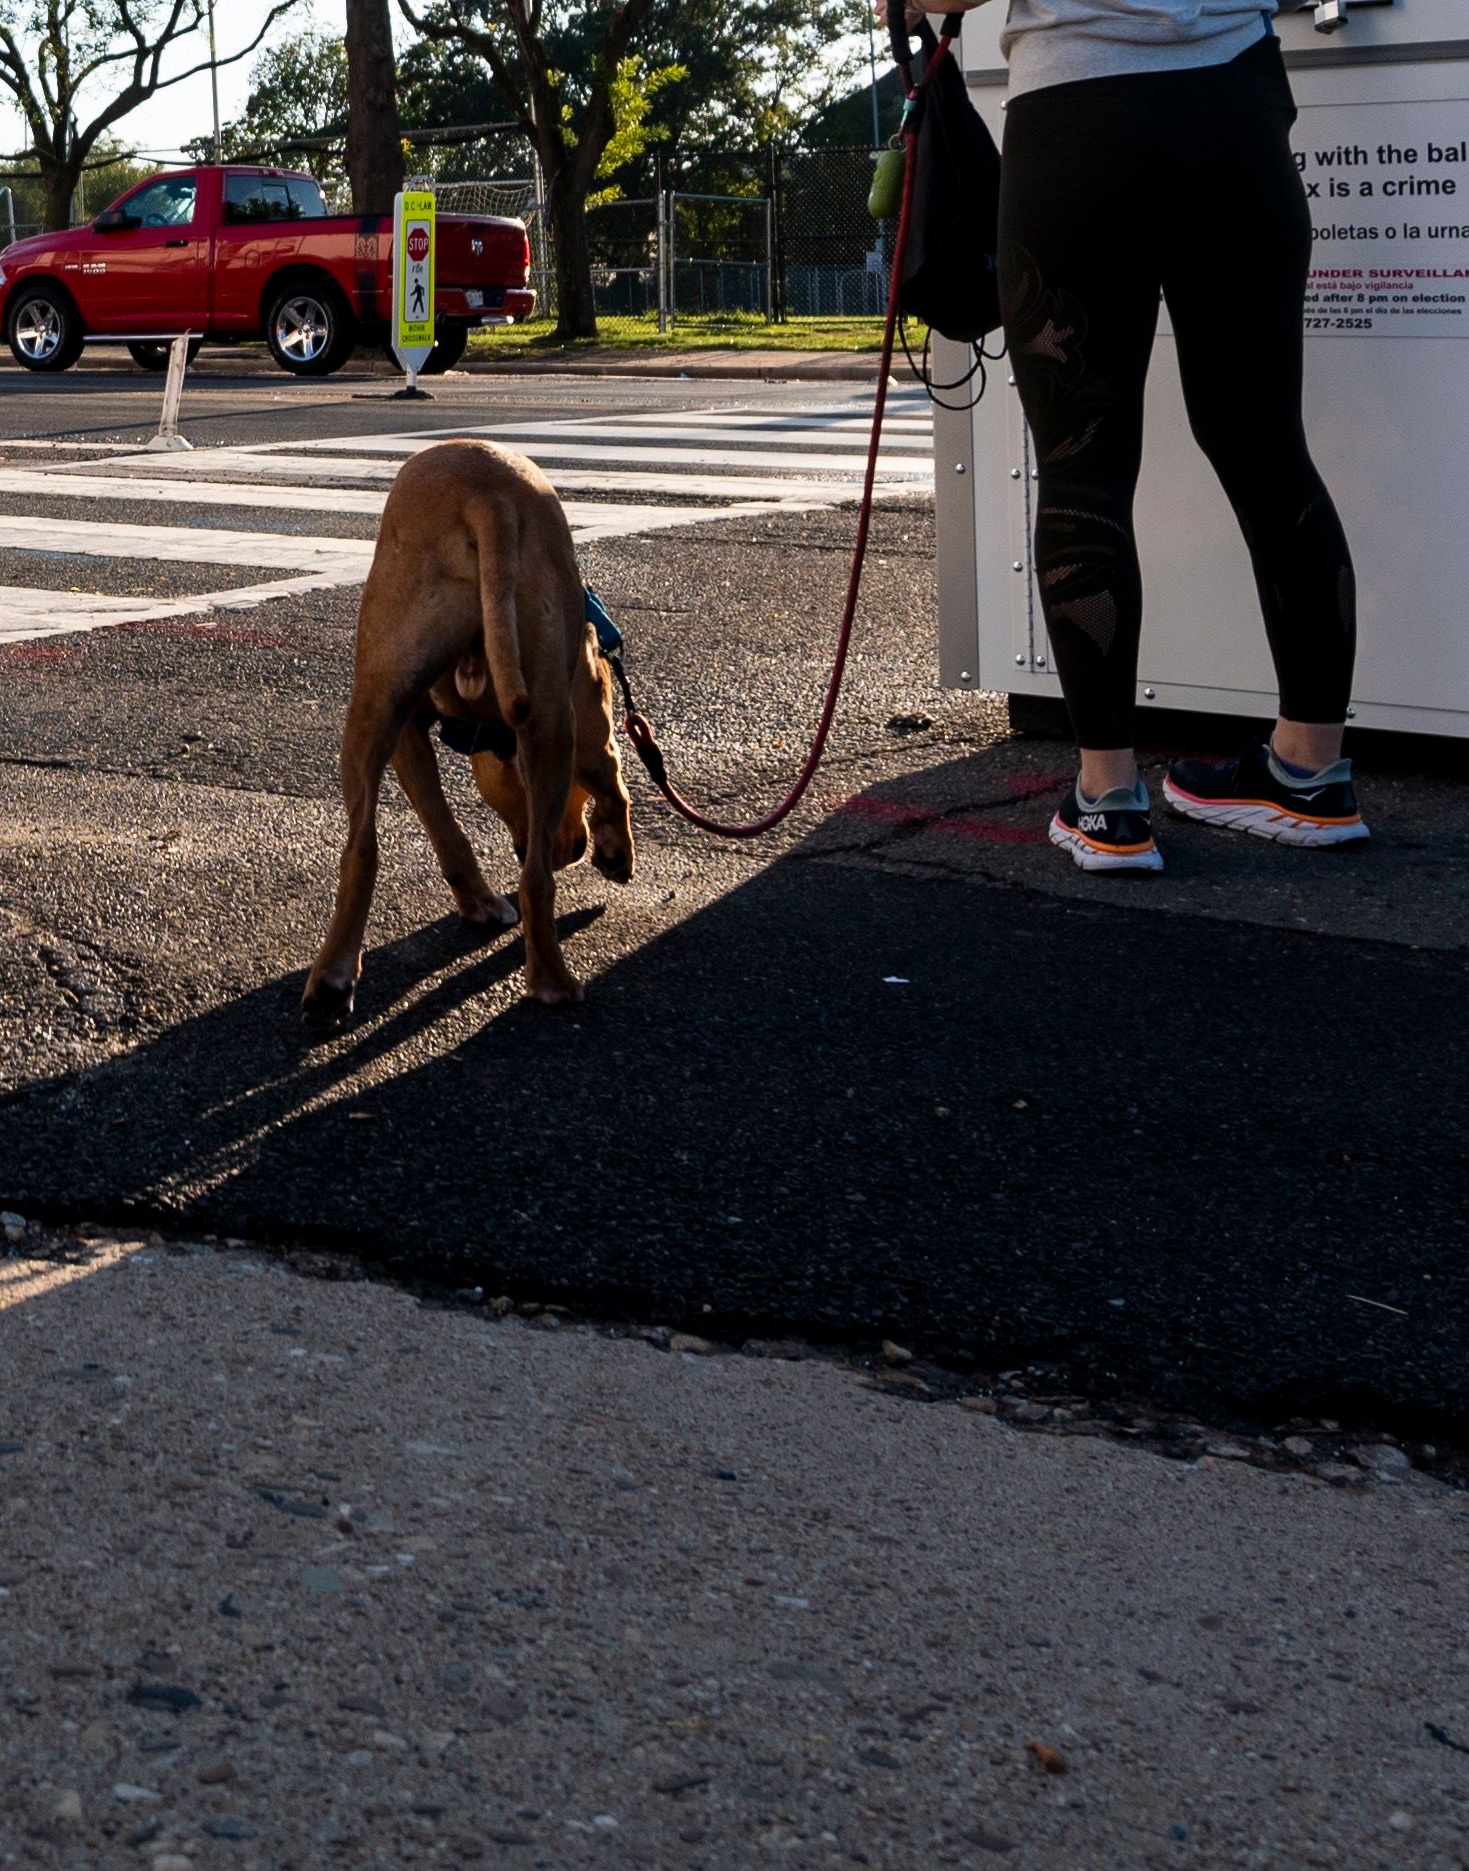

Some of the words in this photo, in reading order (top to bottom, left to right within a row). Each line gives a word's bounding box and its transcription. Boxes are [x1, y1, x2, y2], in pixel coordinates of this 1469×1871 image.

[1314, 145, 1368, 167] with
[1377, 144, 1418, 165] the
[1329, 178, 1350, 198] is
[1359, 180, 1374, 197] a
[1382, 175, 1457, 197] crime
[1385, 225, 1397, 240] o
[1403, 222, 1421, 240] la
[408, 238, 429, 252] STOP
[1307, 269, 1364, 278] UNDER
[1316, 281, 1338, 290] está
[1340, 281, 1362, 291] bajo
[1364, 280, 1414, 292] vigilancia
[1323, 293, 1353, 303] after
[1357, 293, 1365, 303] 8
[1368, 295, 1389, 305] pm
[1392, 295, 1408, 303] on
[1412, 293, 1466, 303] election
[1416, 307, 1462, 315] elecciones
[1304, 318, 1373, 329] 727-2525
[1078, 813, 1108, 832] HOKA
